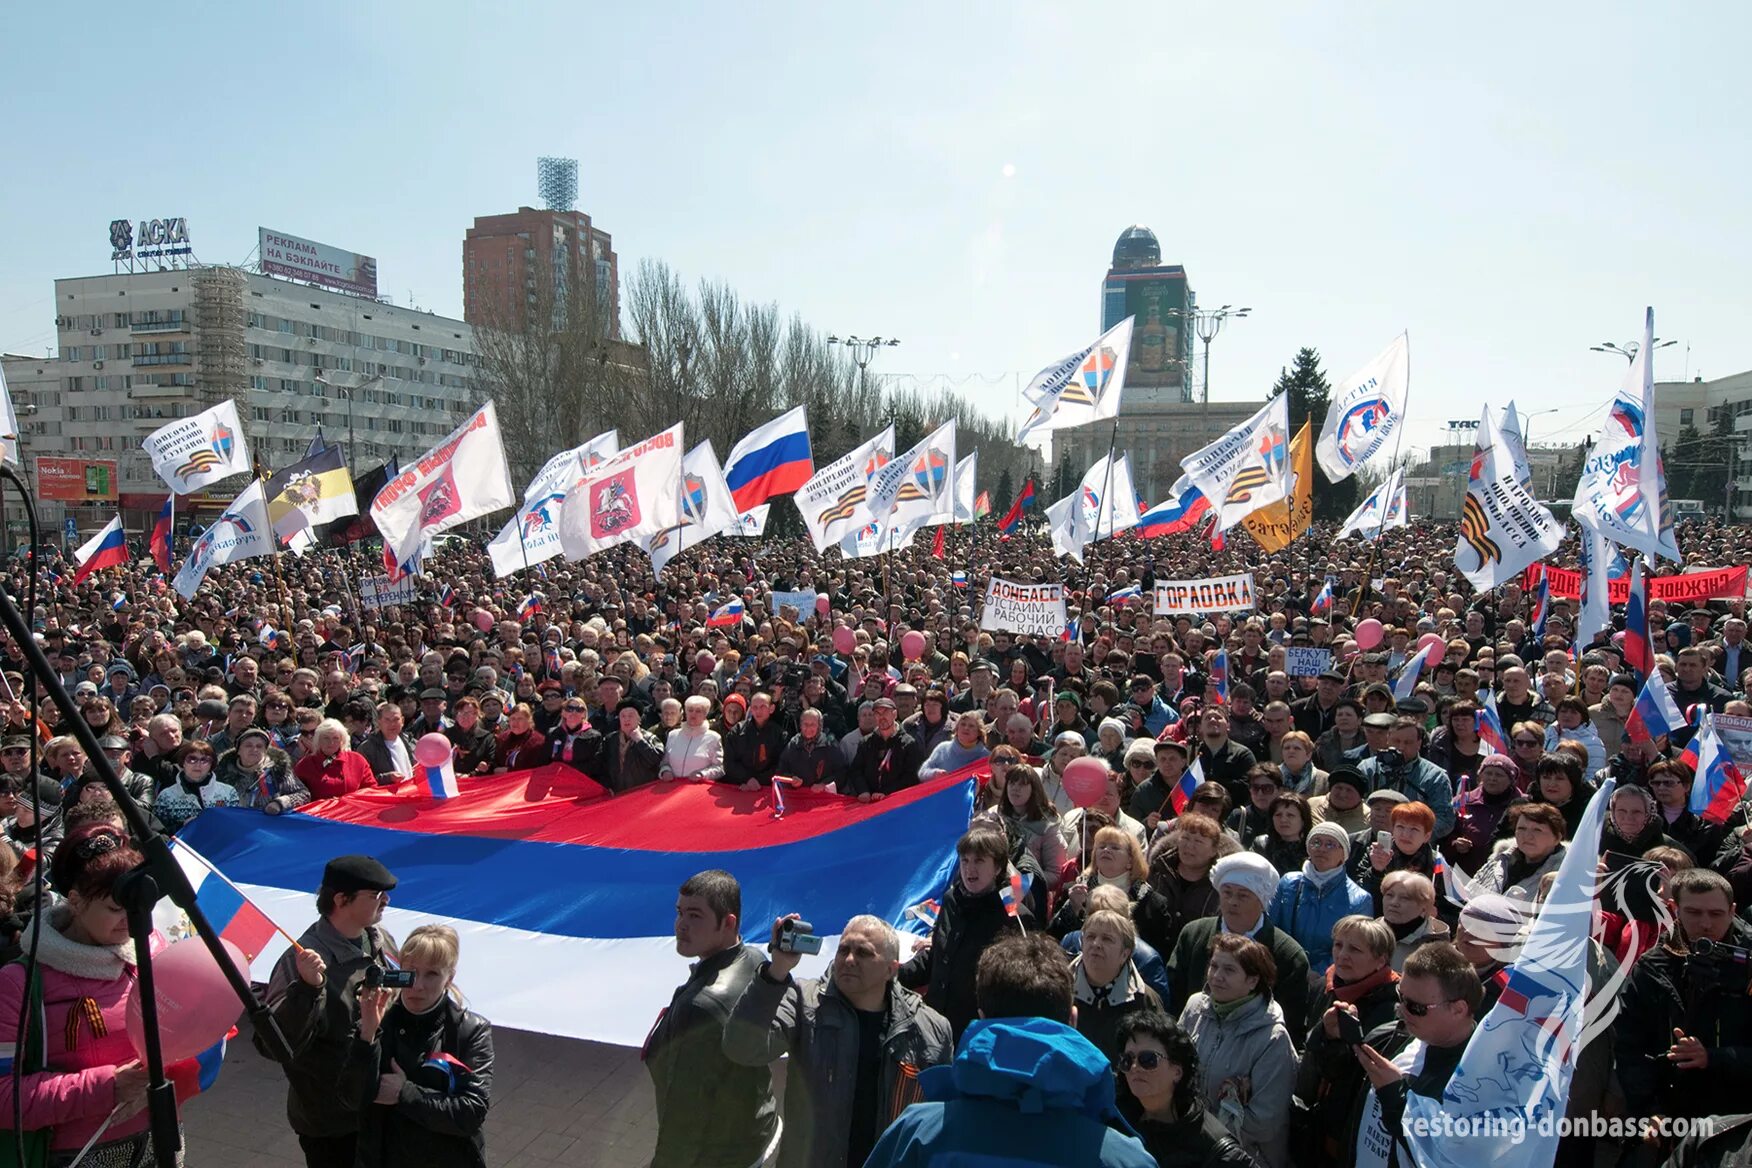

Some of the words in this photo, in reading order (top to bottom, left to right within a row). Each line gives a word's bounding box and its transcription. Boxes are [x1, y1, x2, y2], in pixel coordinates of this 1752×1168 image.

[137, 217, 190, 246] АСКА
[266, 234, 318, 256] РЕКЛАМА
[267, 247, 282, 259] НА
[285, 253, 341, 274] БЭКЛАЙТЕ
[41, 466, 65, 475] Nokia
[1490, 482, 1542, 543] ОПОЛЧЕНИЕ
[1502, 474, 1550, 533] НАРОДНОЕ
[1481, 487, 1527, 549] ДОНБАССА
[985, 595, 1045, 613] ОТСТАИМ
[1156, 580, 1252, 608] ГОРЛОВКА
[994, 608, 1056, 624] РАБОЧИЙ
[1017, 623, 1063, 636] КЛАСС
[1288, 647, 1329, 660] БЕРКУТ
[1297, 658, 1320, 667] НАШ
[1364, 1137, 1388, 1159] ГУБАР
